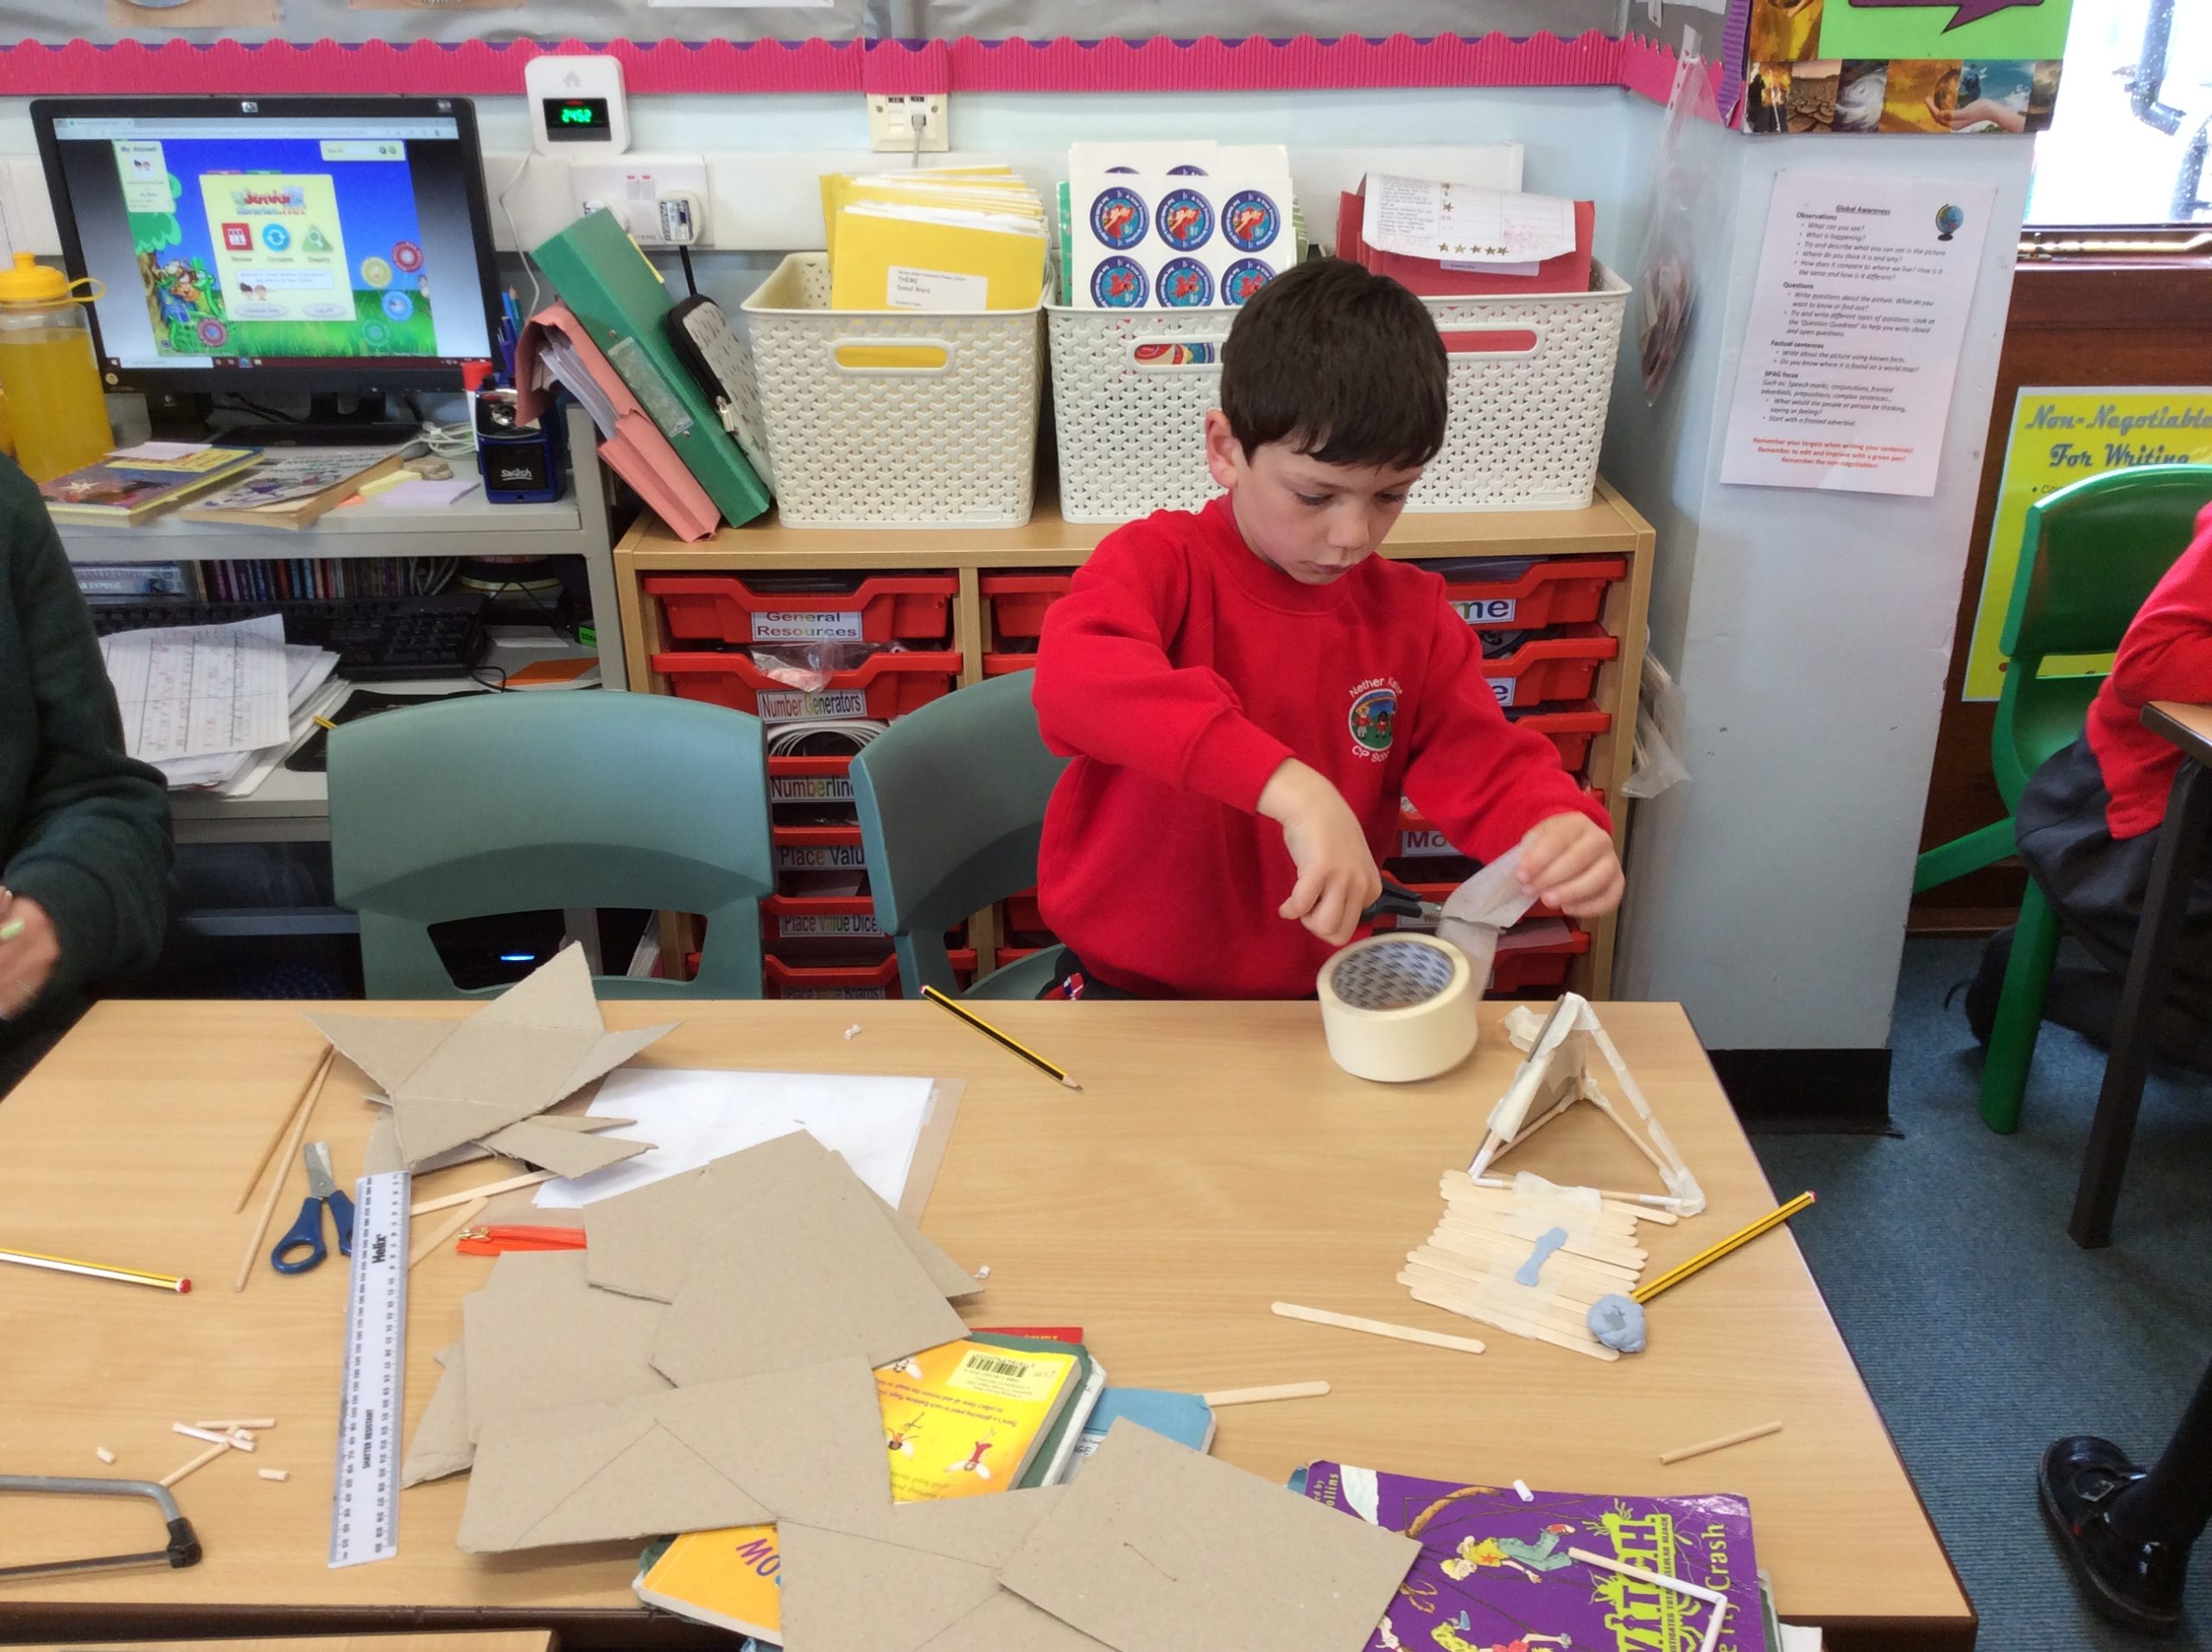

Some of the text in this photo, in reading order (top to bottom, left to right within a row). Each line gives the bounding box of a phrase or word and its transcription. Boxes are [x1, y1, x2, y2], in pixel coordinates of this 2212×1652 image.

[1796, 212, 1836, 220] Observations
[1857, 206, 1891, 214] Awareness
[2049, 443, 2190, 467] For Writing
[766, 612, 841, 622] General
[758, 626, 857, 637] Resources
[1349, 677, 1385, 698] Nether
[761, 691, 861, 718] Number Generators
[1352, 745, 1370, 759] CP
[780, 846, 825, 865] Place
[785, 914, 878, 932] Place Value Dice
[372, 1234, 387, 1263] Helix
[363, 1409, 373, 1469] SHATTER RESISTANT
[1324, 1472, 1338, 1506] ollins
[1660, 1516, 1669, 1543] HIJACK
[1662, 1546, 1671, 1578] ELLULAR
[1700, 1523, 1732, 1591] Crash
